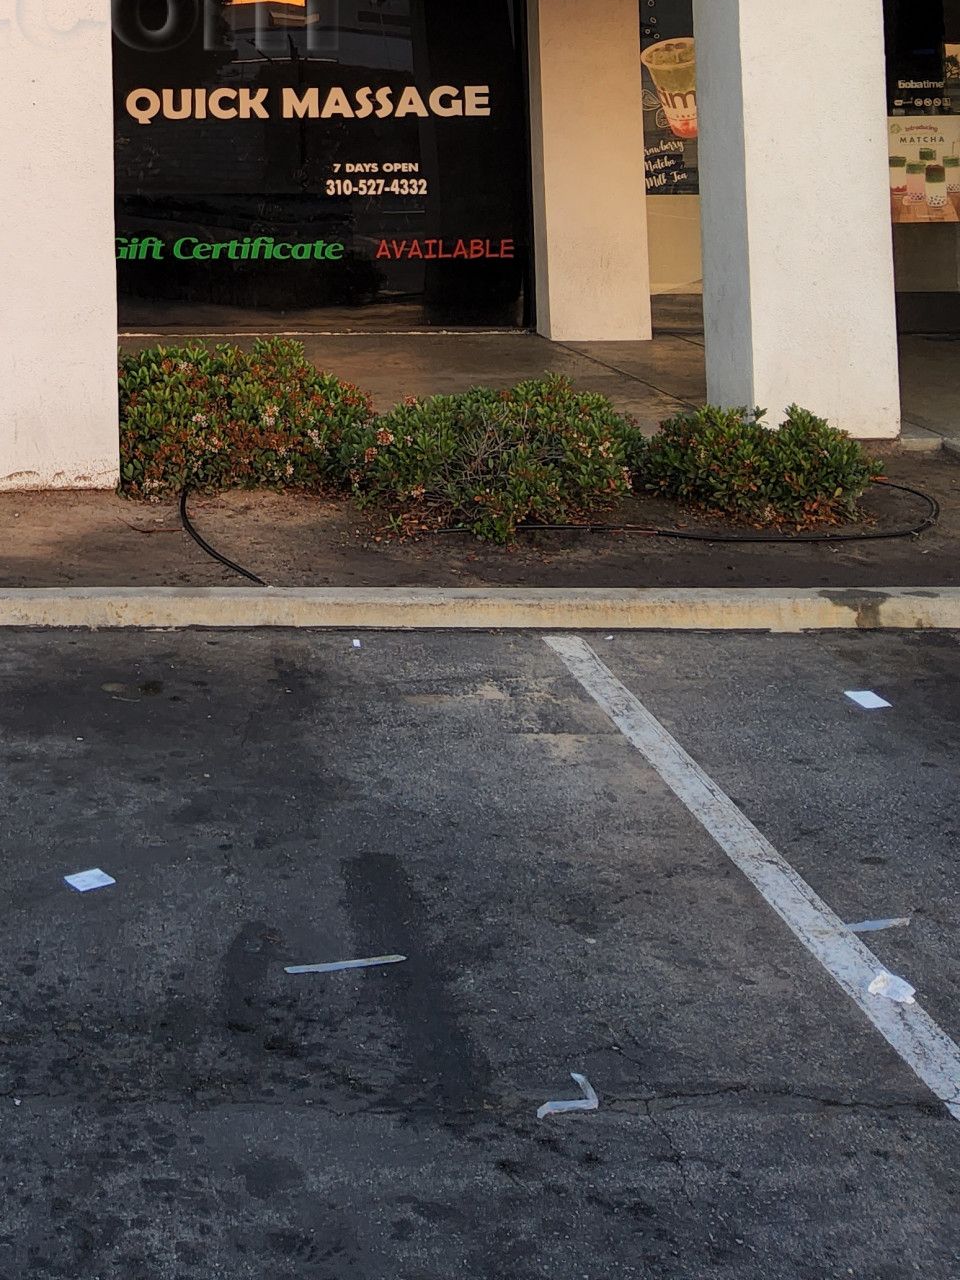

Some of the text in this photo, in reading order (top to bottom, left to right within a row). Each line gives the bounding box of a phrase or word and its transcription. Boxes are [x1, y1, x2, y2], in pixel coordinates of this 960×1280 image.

[125, 84, 492, 125] QUICK MASSAGE
[332, 162, 420, 174] 7 DAYS OPEN
[325, 178, 429, 196] 310-527-4332
[173, 235, 344, 260] Certificate
[375, 238, 515, 259] AVAILABLE
